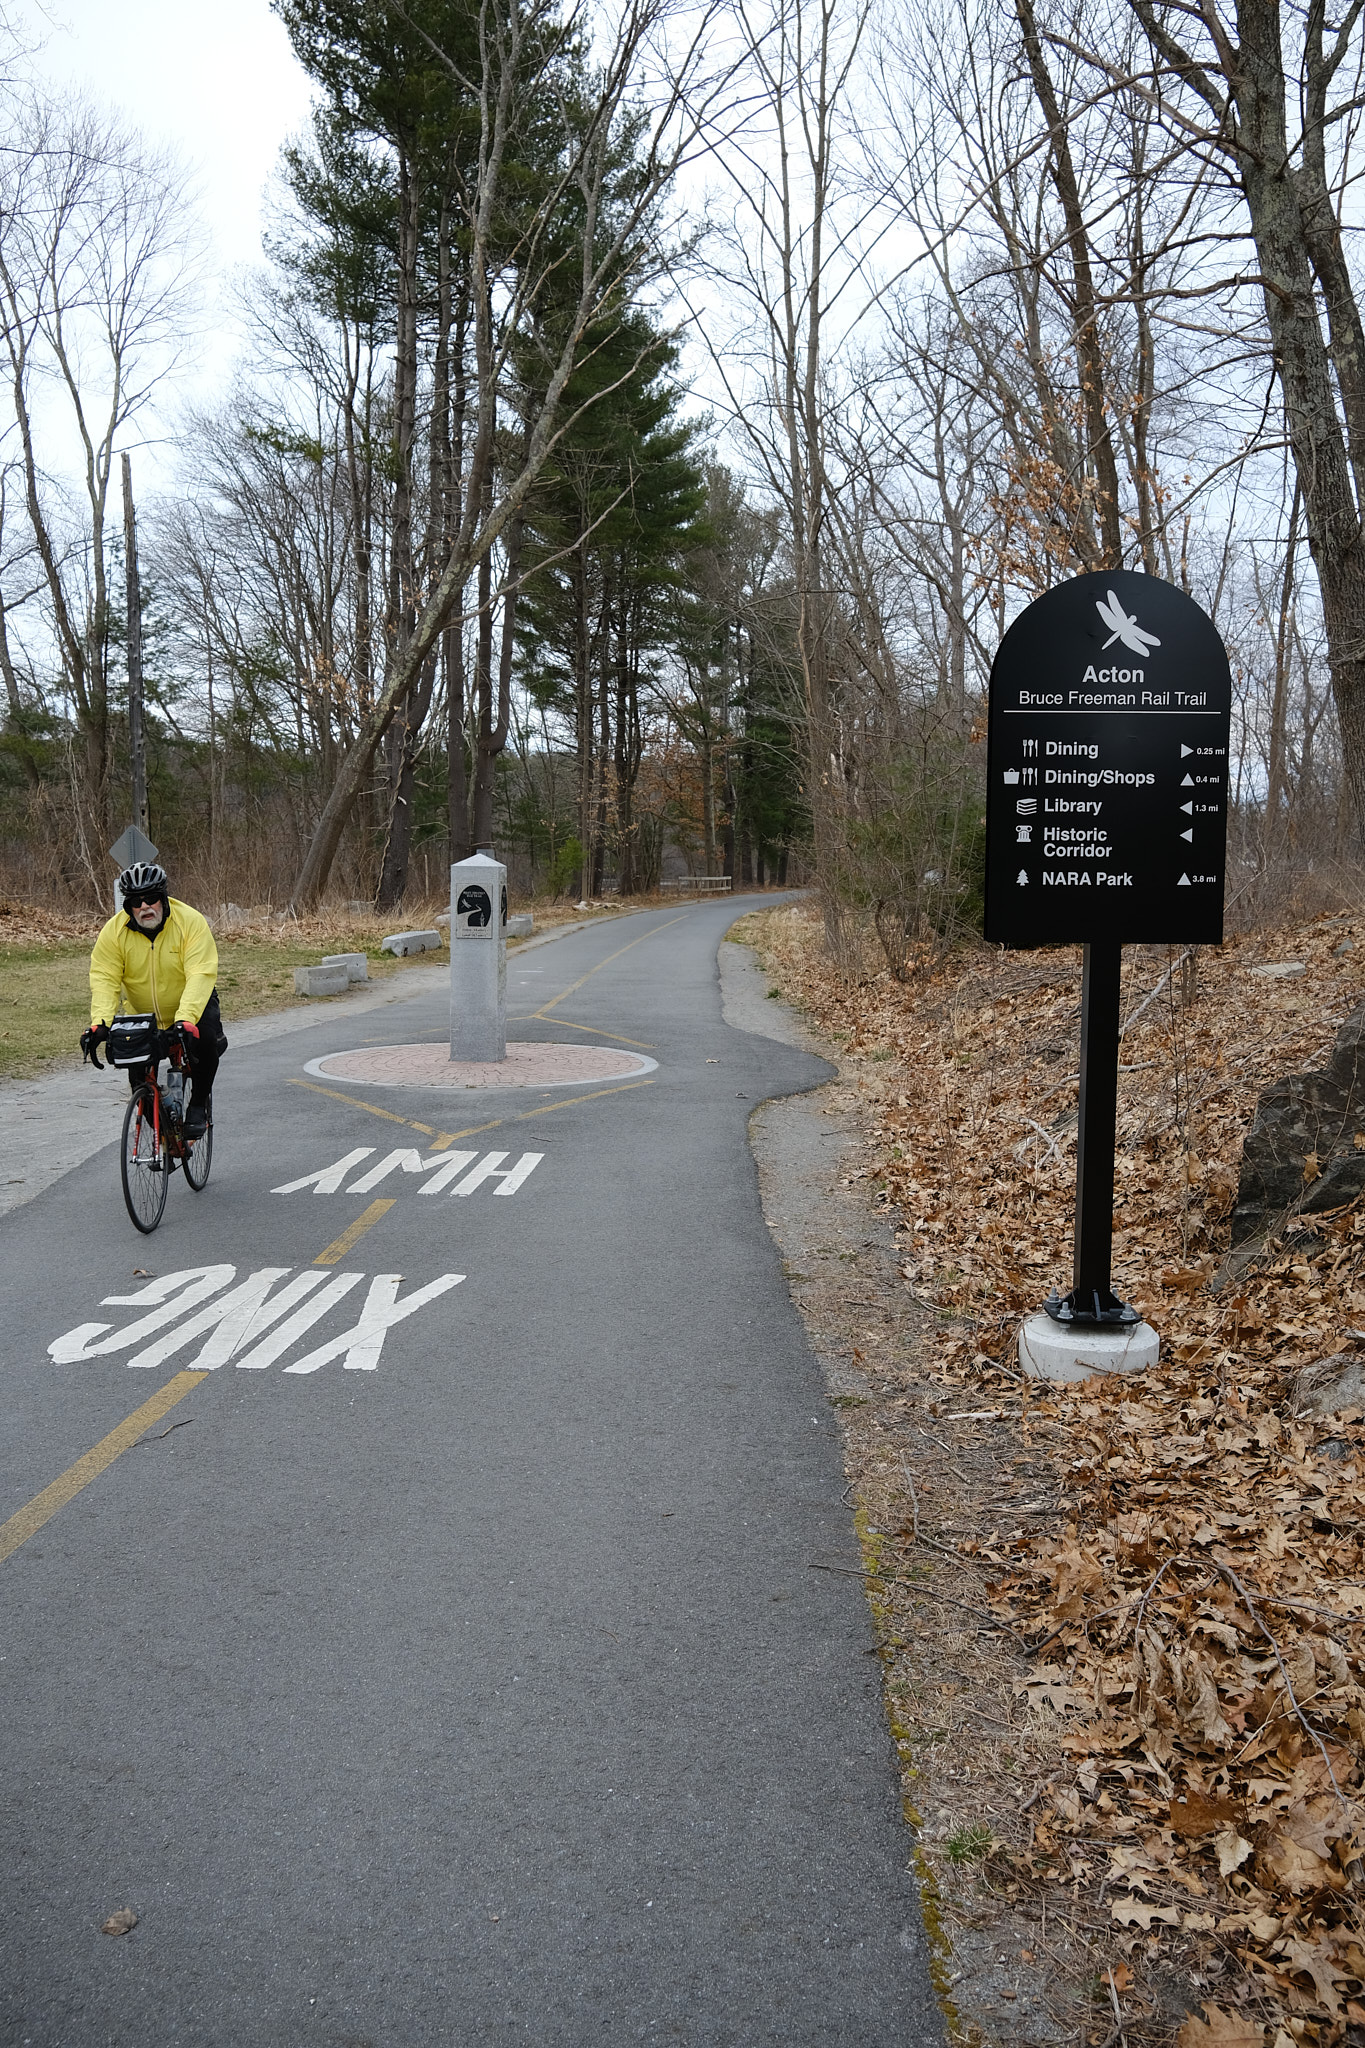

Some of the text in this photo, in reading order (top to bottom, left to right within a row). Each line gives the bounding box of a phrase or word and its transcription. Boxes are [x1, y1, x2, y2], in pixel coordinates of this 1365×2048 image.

[1082, 665, 1144, 683] Acton
[1019, 691, 1207, 706] Bruce Freeman Rail Trail
[1045, 741, 1099, 760] Dining
[1196, 747, 1225, 755] 0.25 mi
[1044, 769, 1156, 788] Dining/Shops
[1195, 775, 1220, 784] 0.4 mi
[1044, 798, 1103, 816] Library
[1194, 804, 1219, 812] 1.3 mi
[1043, 827, 1108, 842] Historic
[1043, 843, 1113, 858] Corridor
[1042, 871, 1133, 886] NARA Park
[1192, 875, 1217, 883] 3.8 mi
[270, 1147, 545, 1196] HWY
[47, 1263, 467, 1375] XING
